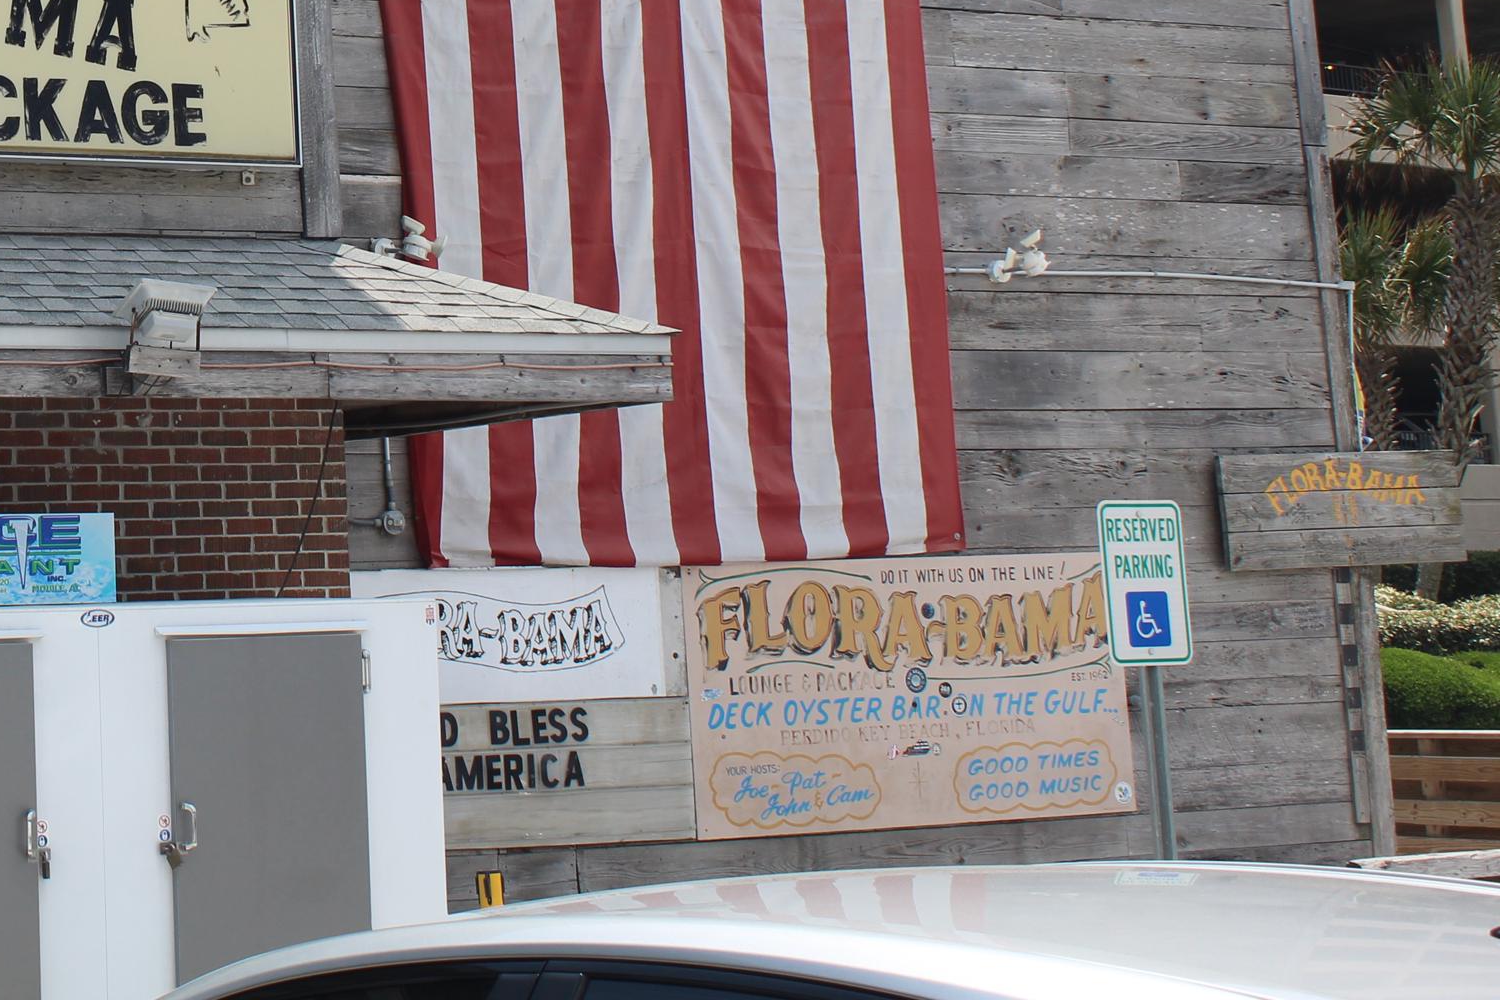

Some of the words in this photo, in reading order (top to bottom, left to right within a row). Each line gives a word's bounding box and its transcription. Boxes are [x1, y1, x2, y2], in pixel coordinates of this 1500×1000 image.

[1105, 517, 1176, 543] RESERVED
[880, 569, 894, 584] DO
[899, 569, 909, 583] IT
[916, 567, 945, 583] WITH
[948, 567, 964, 583] US
[969, 567, 985, 582] ON
[991, 566, 1016, 581] THE
[1114, 553, 1175, 579] PARKING
[729, 673, 793, 695] LOUNGE
[817, 671, 896, 692] PACKAGE
[708, 701, 773, 729] DECK
[783, 696, 883, 726] OYSTER
[993, 691, 1038, 716] THE
[488, 706, 589, 746] BLESS
[781, 727, 849, 746] PERDIDO
[858, 725, 891, 742] KEY
[966, 718, 1036, 737] FLORIDA
[726, 765, 747, 776] YOUR
[967, 756, 1028, 776] GOOD
[1038, 750, 1100, 771] TIMES
[968, 781, 1029, 801] GOOD
[1038, 775, 1102, 796] MUSIC
[761, 793, 812, 820] John
[826, 785, 874, 806] Cam
